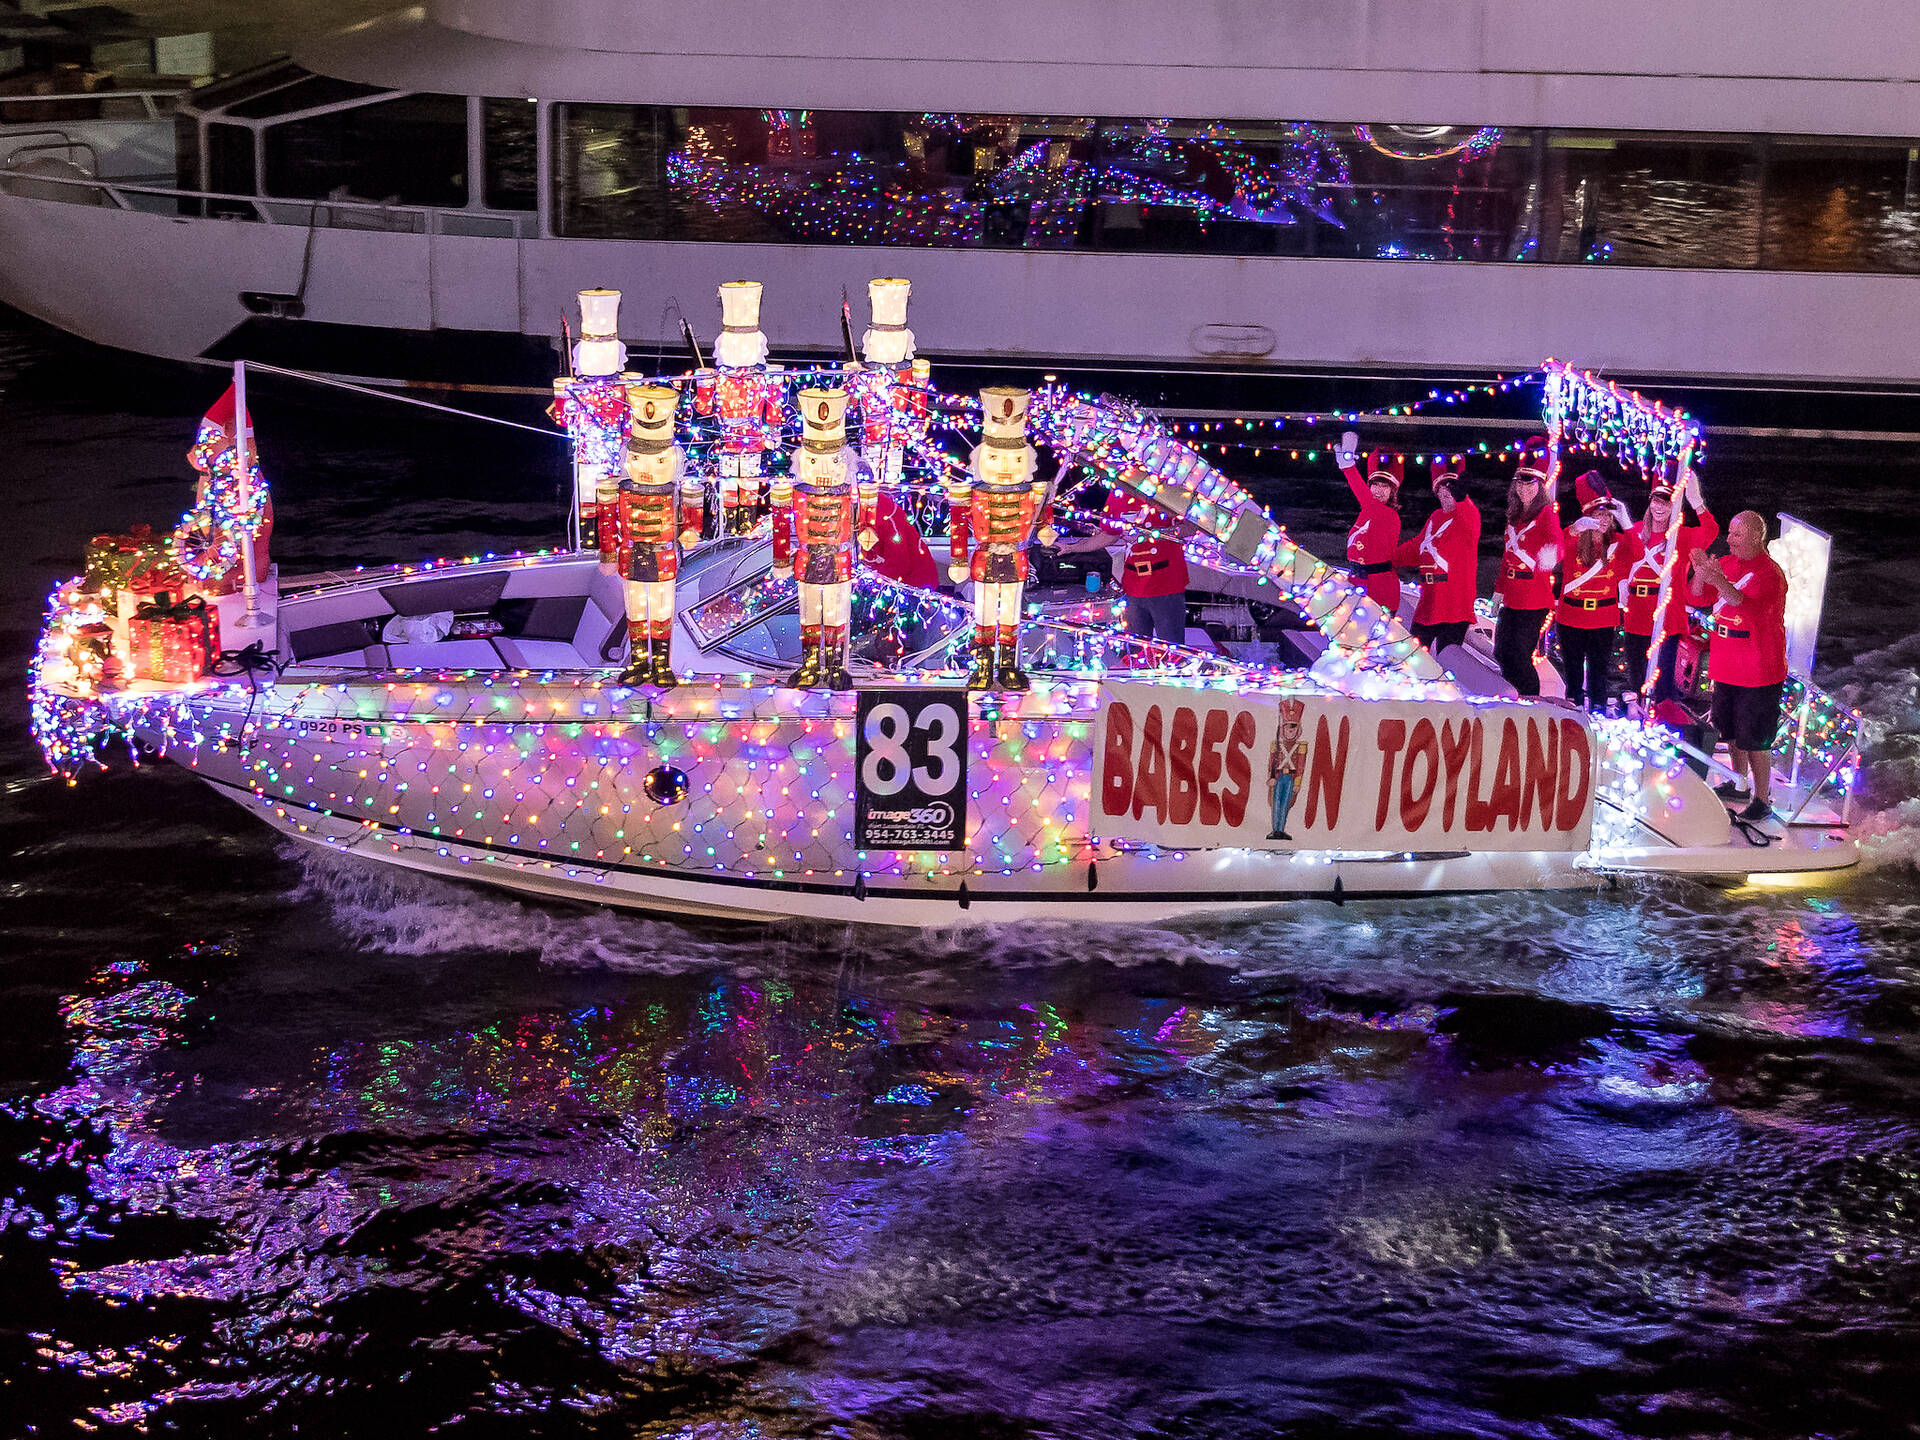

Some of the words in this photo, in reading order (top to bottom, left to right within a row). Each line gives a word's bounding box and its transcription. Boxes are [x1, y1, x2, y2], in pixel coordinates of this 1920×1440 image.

[300, 720, 337, 733] 0920
[343, 723, 363, 734] PS
[862, 702, 961, 796] 83
[1103, 701, 1256, 828] BABES
[1375, 716, 1591, 833] TOYLAND
[867, 808, 947, 823] image360
[865, 829, 955, 839] 954-763-3445
